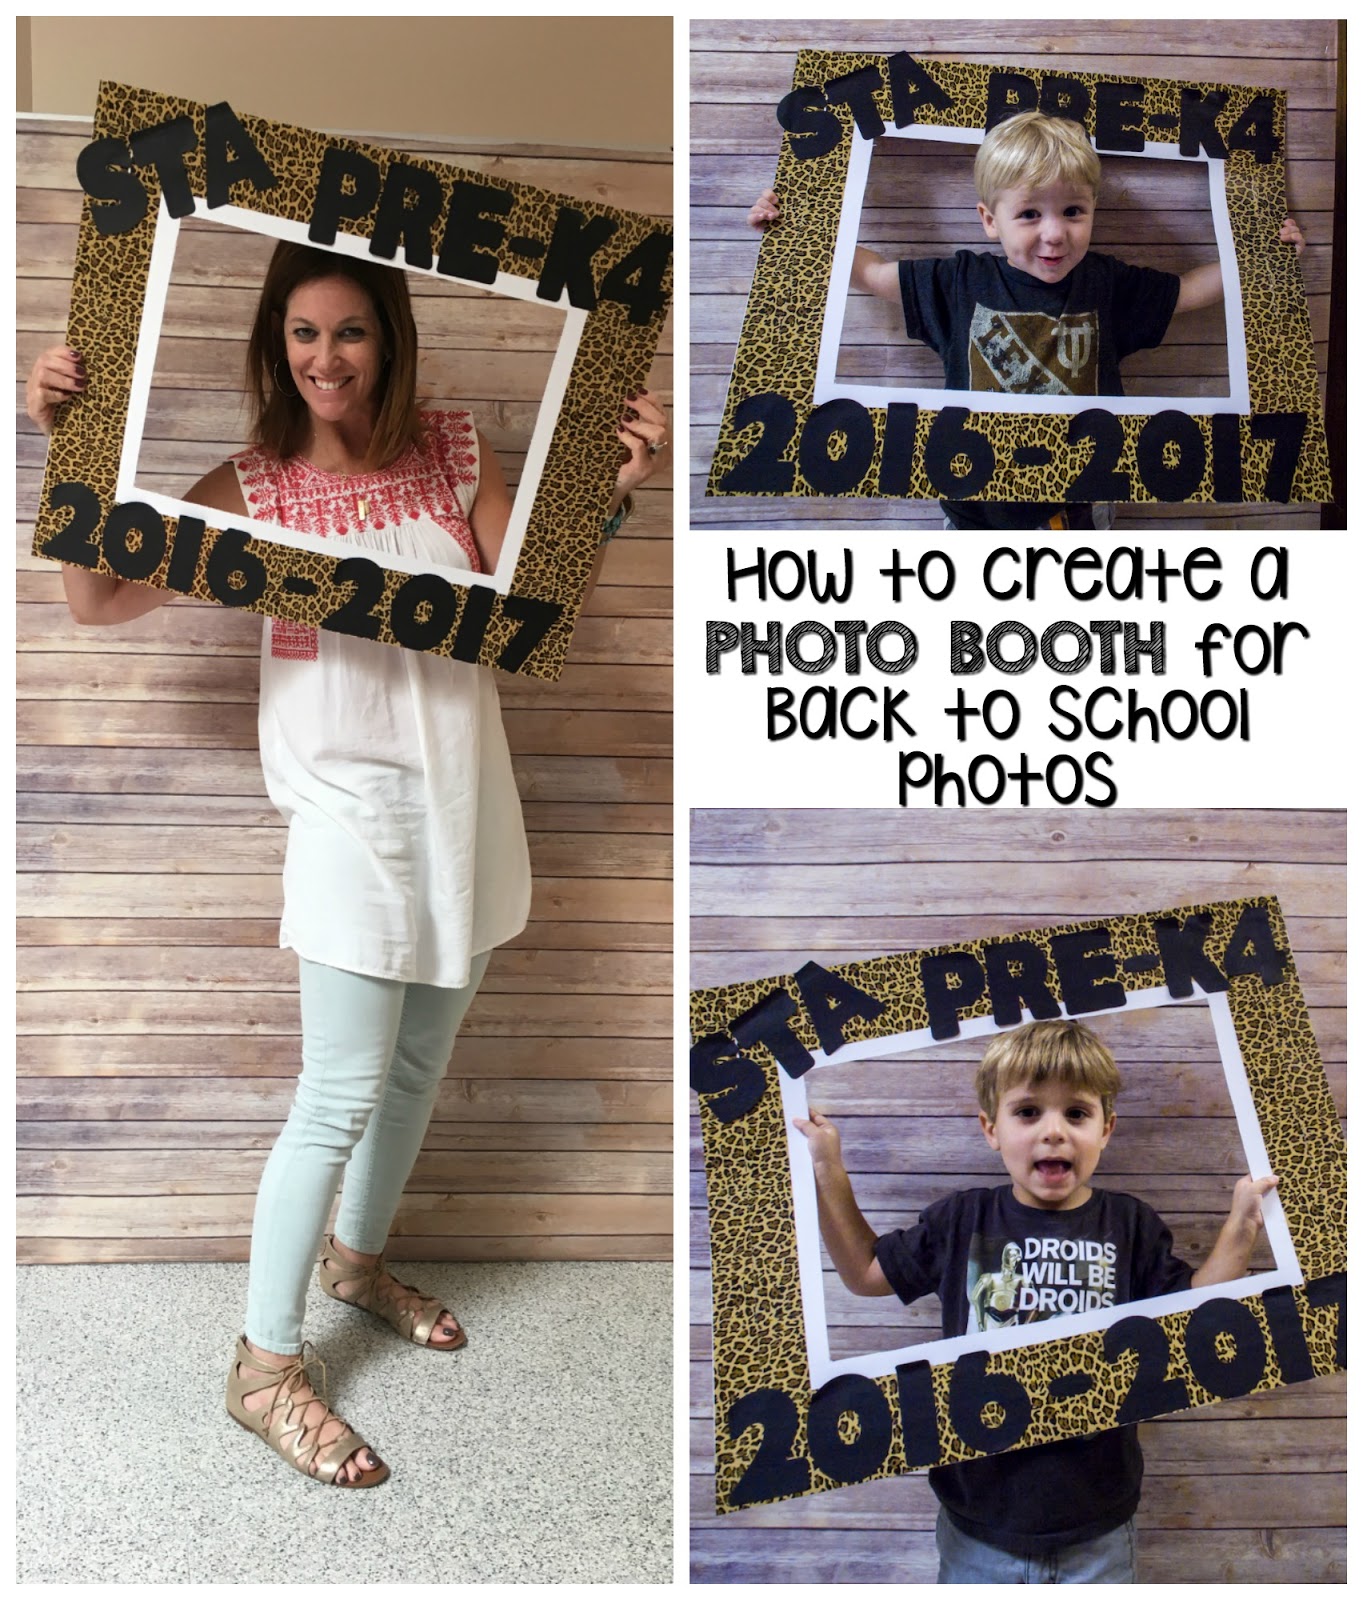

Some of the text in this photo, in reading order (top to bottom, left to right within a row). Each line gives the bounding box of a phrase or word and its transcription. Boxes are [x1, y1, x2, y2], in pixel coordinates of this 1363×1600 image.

[776, 50, 953, 160] STA
[76, 101, 673, 326] STA PRE-K4
[718, 392, 1309, 503] 2016-2017
[42, 481, 566, 674] 2016-2017
[690, 907, 1289, 1123] STA PRE-K4
[1019, 1287, 1115, 1313] DROIDS
[1021, 1261, 1117, 1289] WILL BE
[1024, 1237, 1117, 1265] DROIDS
